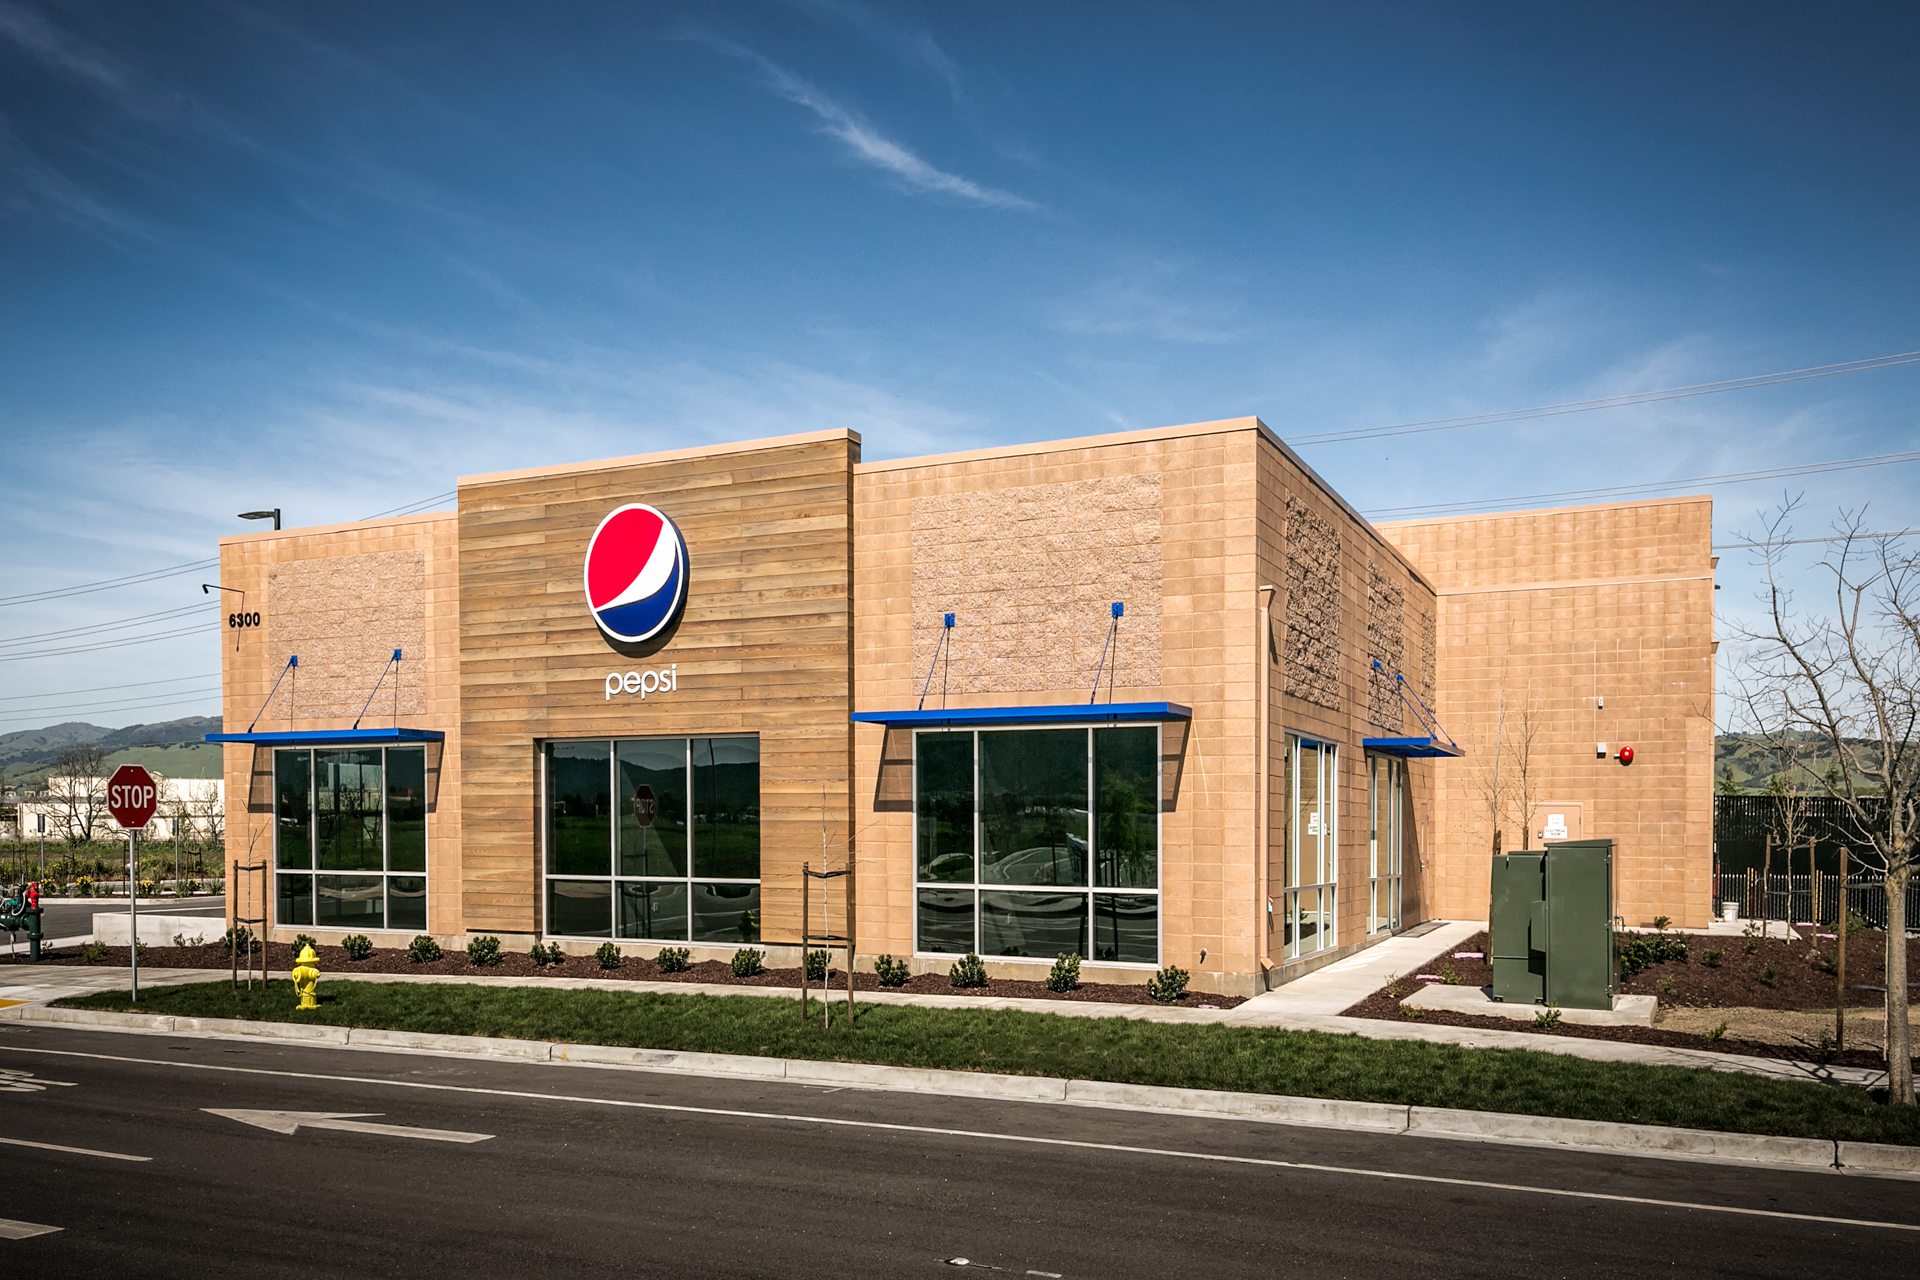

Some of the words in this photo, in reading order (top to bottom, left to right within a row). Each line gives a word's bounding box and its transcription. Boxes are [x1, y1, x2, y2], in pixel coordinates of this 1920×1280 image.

[229, 612, 260, 628] 6300
[605, 663, 677, 701] pepsi
[111, 785, 154, 809] STOP
